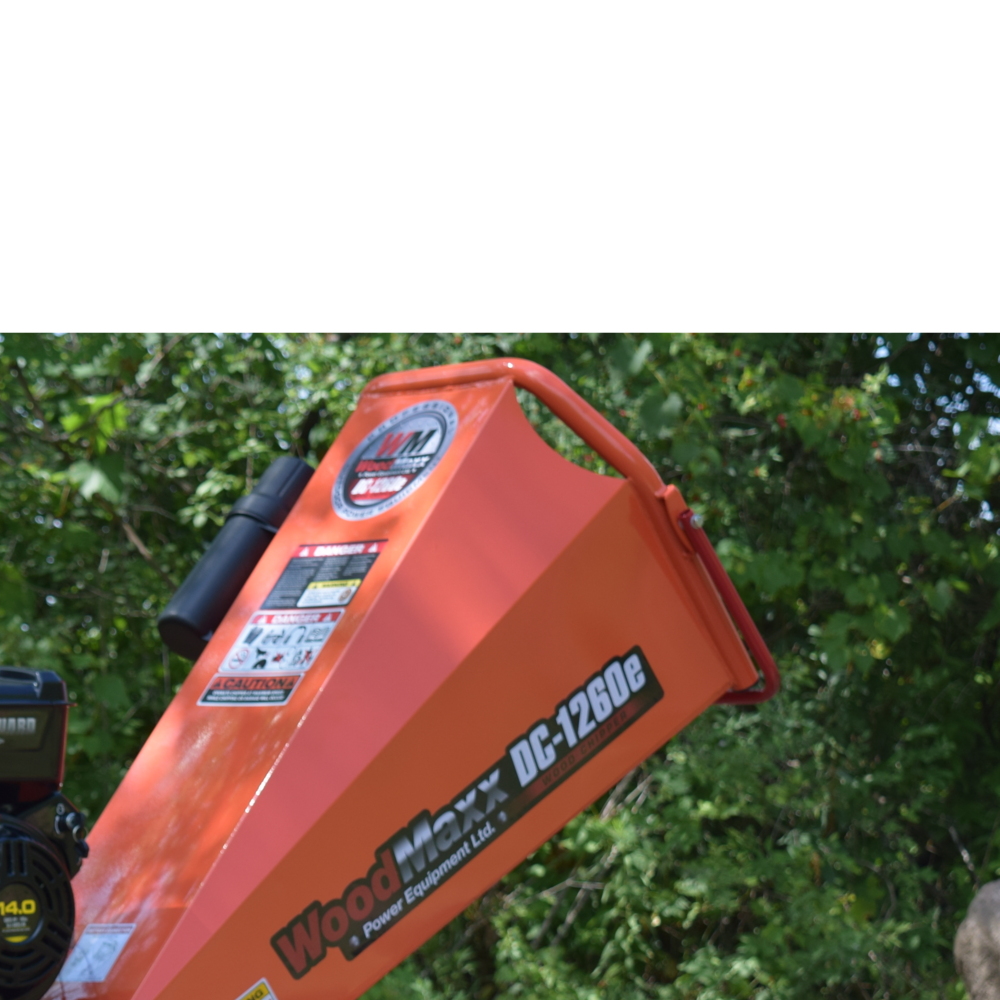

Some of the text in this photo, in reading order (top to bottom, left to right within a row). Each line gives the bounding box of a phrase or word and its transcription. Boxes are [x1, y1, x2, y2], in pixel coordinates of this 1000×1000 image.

[223, 677, 288, 690] CAUTION
[510, 652, 647, 788] DC-1260e
[276, 767, 509, 975] WoodMaxx
[362, 821, 497, 939] Power Equipment Ltd.
